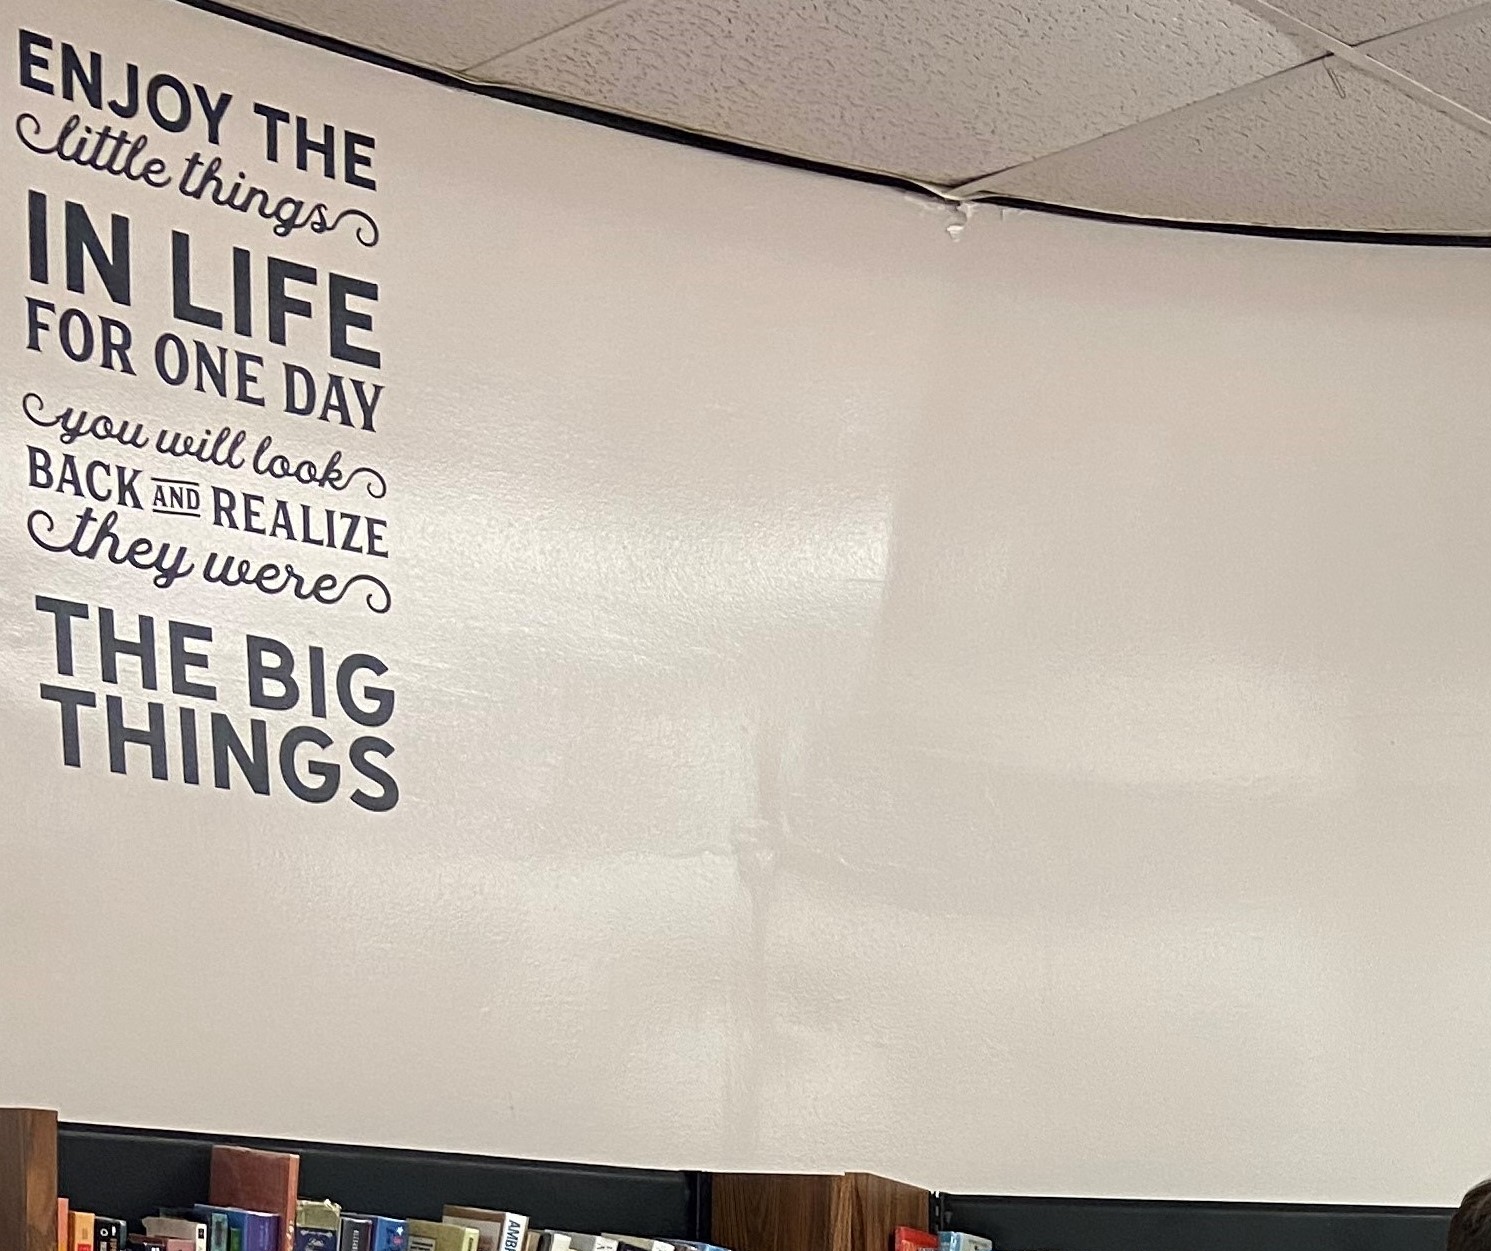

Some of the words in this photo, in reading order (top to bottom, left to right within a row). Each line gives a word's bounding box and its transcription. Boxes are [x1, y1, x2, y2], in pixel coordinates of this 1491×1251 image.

[19, 29, 233, 144] ENJOY
[253, 103, 377, 191] THE
[16, 113, 172, 187] little
[178, 152, 379, 247] things
[29, 190, 131, 306] IN
[172, 230, 381, 369] LIFE
[25, 297, 137, 375] FOR
[155, 333, 265, 406] ONE
[283, 362, 385, 432] DAY
[23, 393, 149, 444] you
[156, 427, 245, 469] will
[253, 436, 387, 498] look
[27, 445, 144, 510] BACK
[152, 483, 200, 512] AND
[212, 486, 389, 558] REALIZE
[27, 507, 194, 589] they
[203, 552, 391, 613] were
[35, 595, 217, 701] THE
[247, 634, 395, 727] BIG
[40, 683, 399, 812] THINGS
